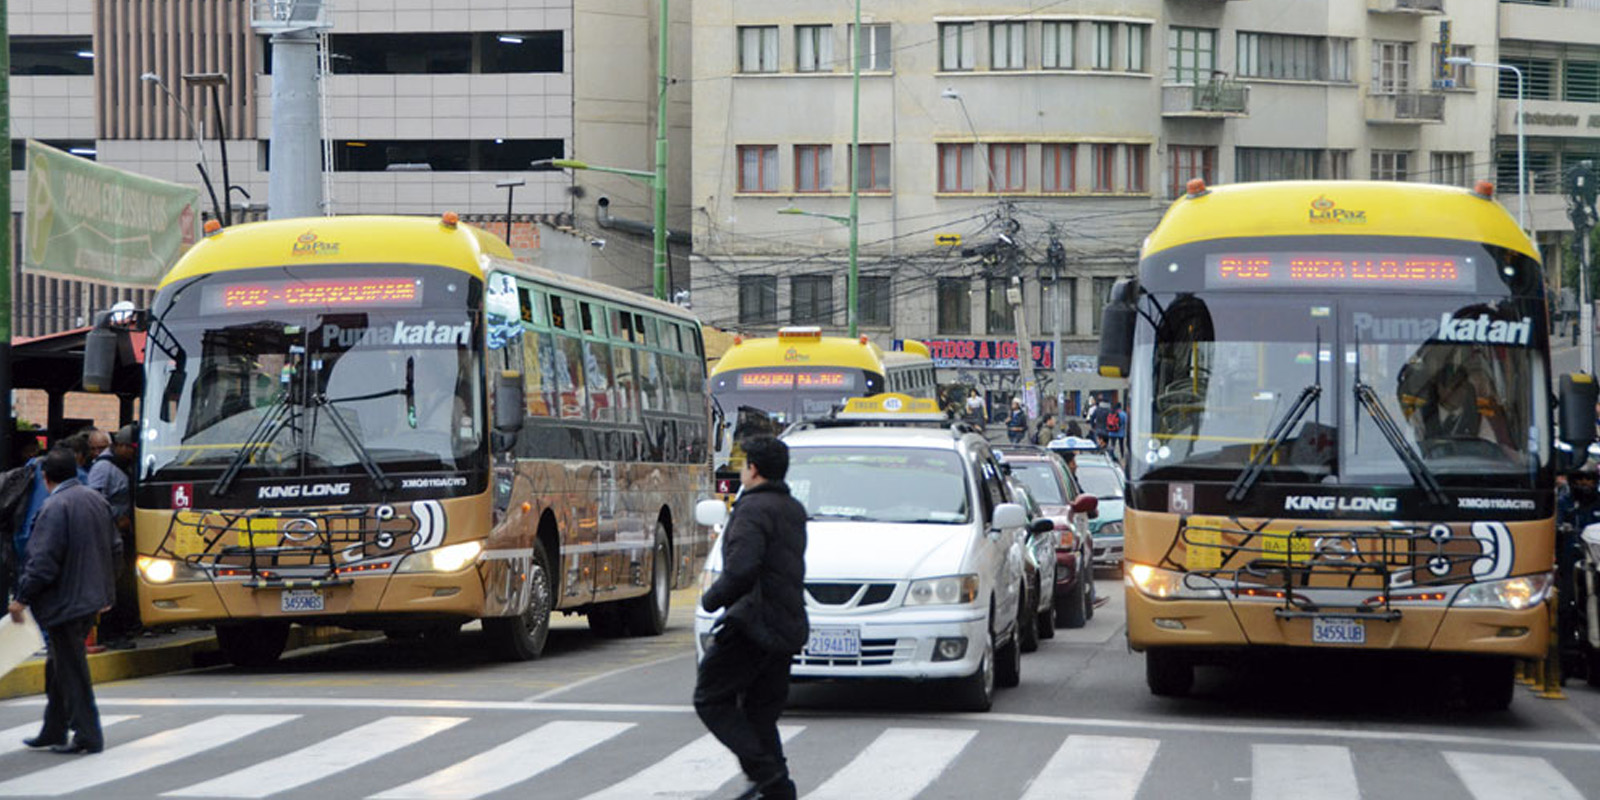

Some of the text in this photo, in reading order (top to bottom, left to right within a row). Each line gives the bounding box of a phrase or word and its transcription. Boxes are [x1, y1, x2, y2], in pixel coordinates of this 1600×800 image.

[1221, 258, 1269, 279] PUC
[226, 288, 269, 307] PUC
[322, 320, 472, 347] Pumakatari
[1353, 312, 1531, 345] Pumakatari
[259, 483, 351, 498] KING LONG
[1285, 496, 1397, 511] KING LONG
